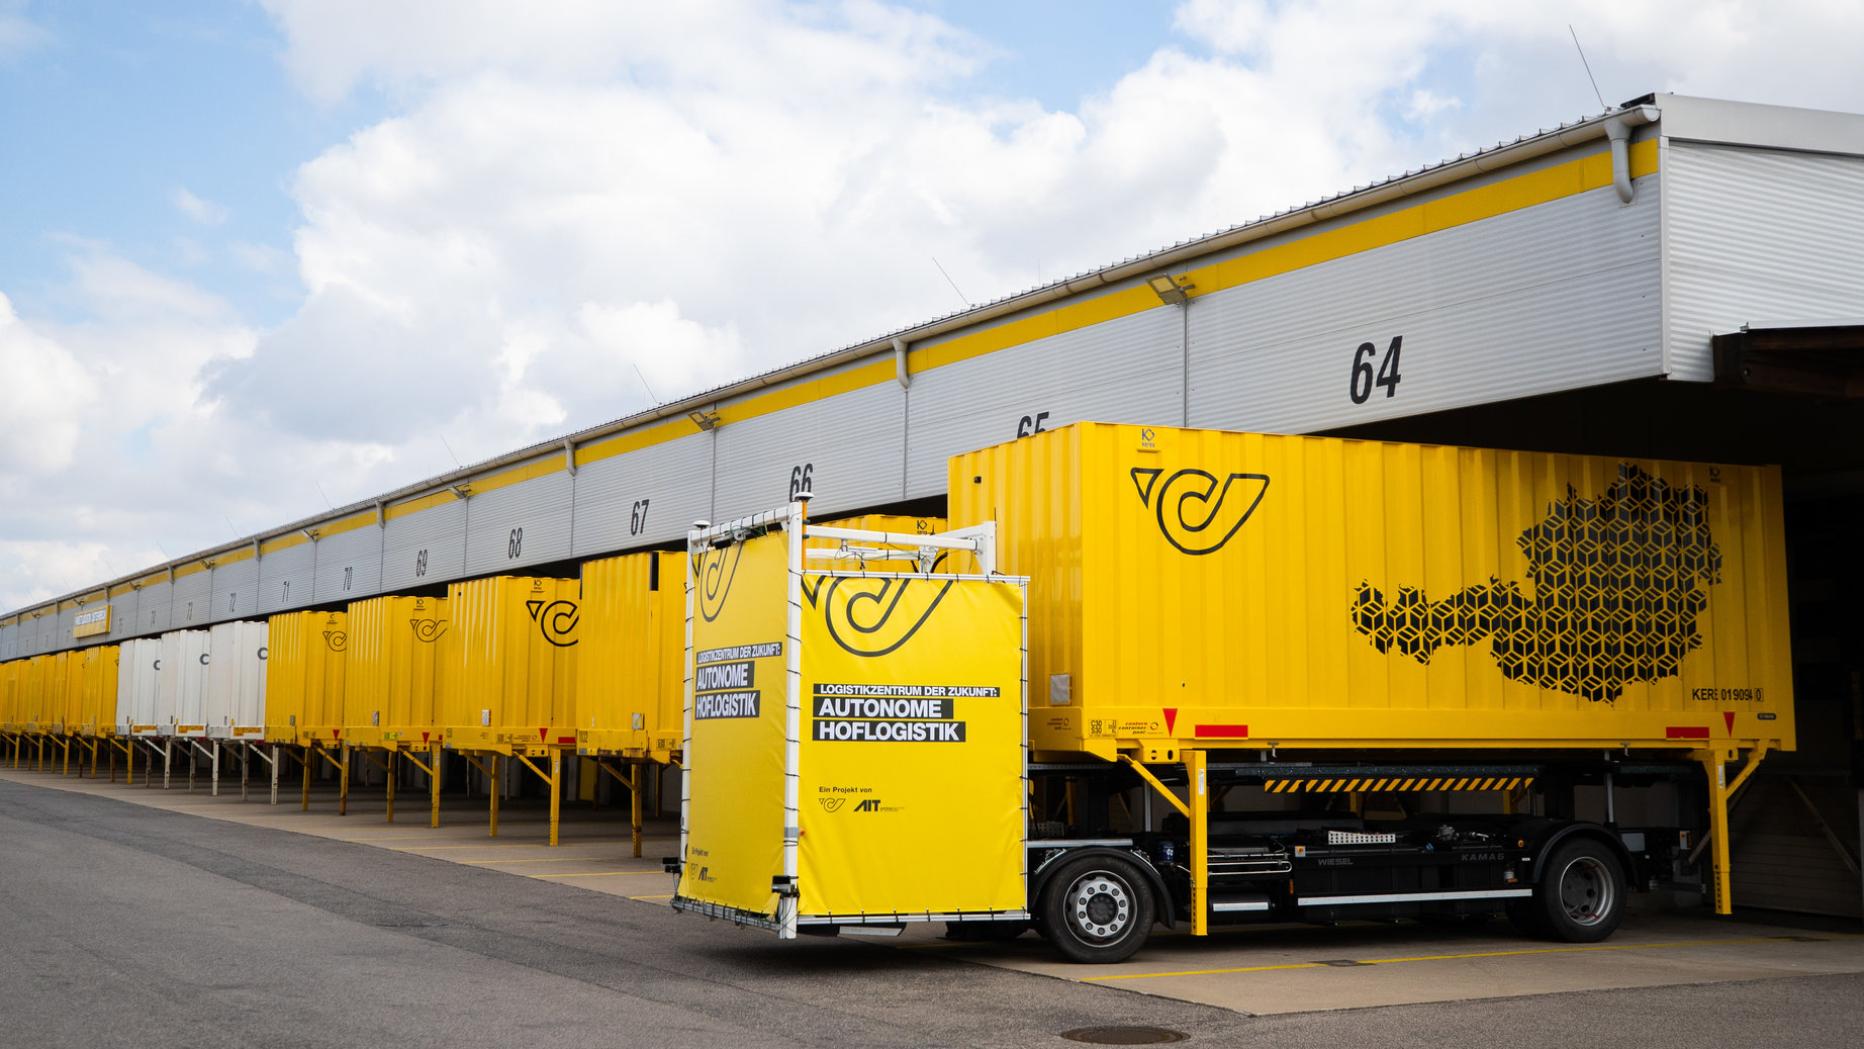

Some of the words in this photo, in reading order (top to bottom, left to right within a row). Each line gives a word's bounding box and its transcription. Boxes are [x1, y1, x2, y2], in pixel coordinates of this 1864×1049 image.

[1350, 335, 1403, 405] 64
[789, 463, 813, 503] 66
[630, 499, 650, 536] 67
[508, 527, 523, 560] 68
[415, 549, 429, 577] 69
[343, 566, 353, 591] 70
[282, 580, 290, 603] 71
[740, 645, 751, 659] DER
[697, 663, 749, 690] AUTONOME
[820, 684, 922, 697] LOGISTIKZENTRUM
[924, 686, 946, 697] DER
[948, 686, 998, 698] ZUKUNFT:
[696, 692, 757, 718] HOFLOGISTIK
[819, 698, 942, 718] AUTONOME
[819, 721, 960, 741] HOFLOGISTIK
[832, 786, 858, 794] Projekt
[853, 799, 881, 812] AIT
[1317, 857, 1354, 867] WIESEL
